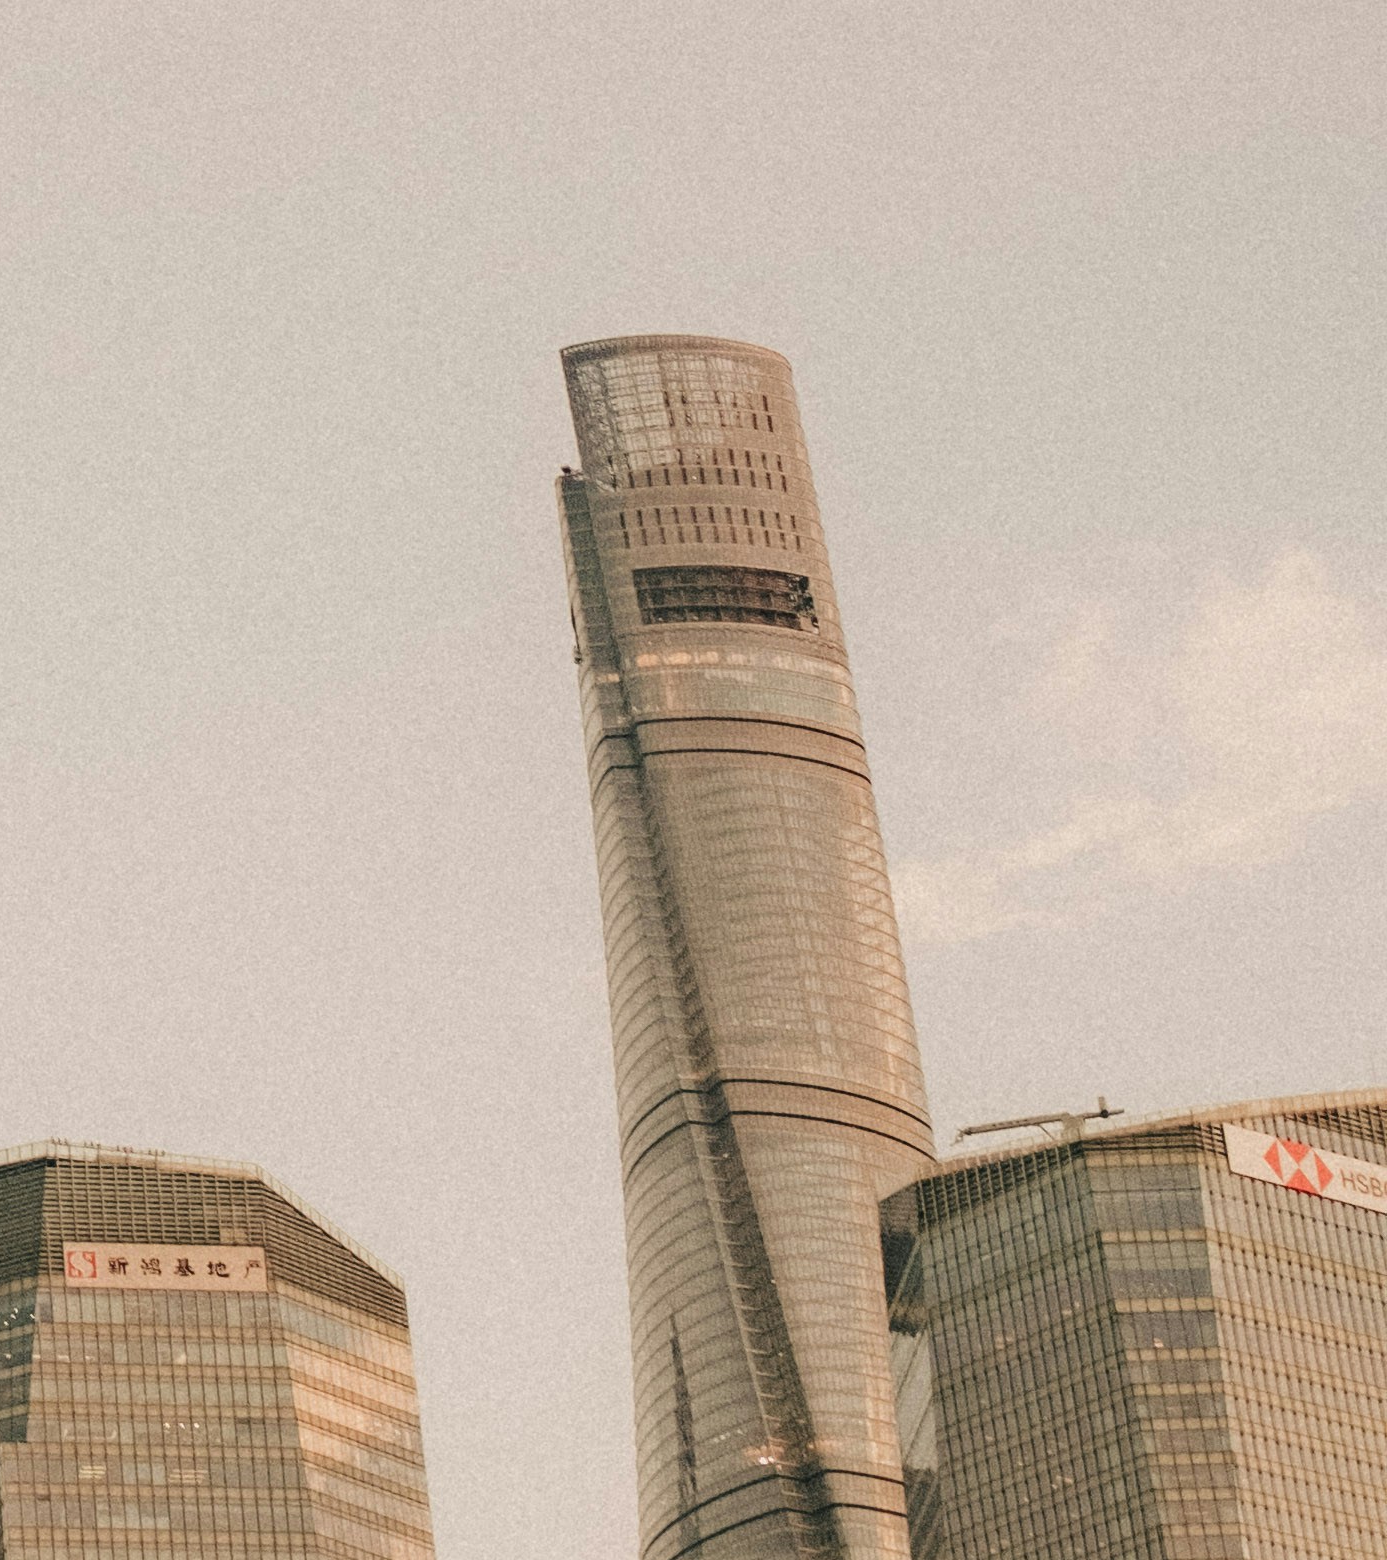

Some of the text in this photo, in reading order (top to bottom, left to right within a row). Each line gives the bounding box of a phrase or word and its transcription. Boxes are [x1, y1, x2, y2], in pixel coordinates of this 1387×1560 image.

[1339, 1168, 1387, 1198] HSB
[108, 1256, 262, 1278] 新鸿基地产
